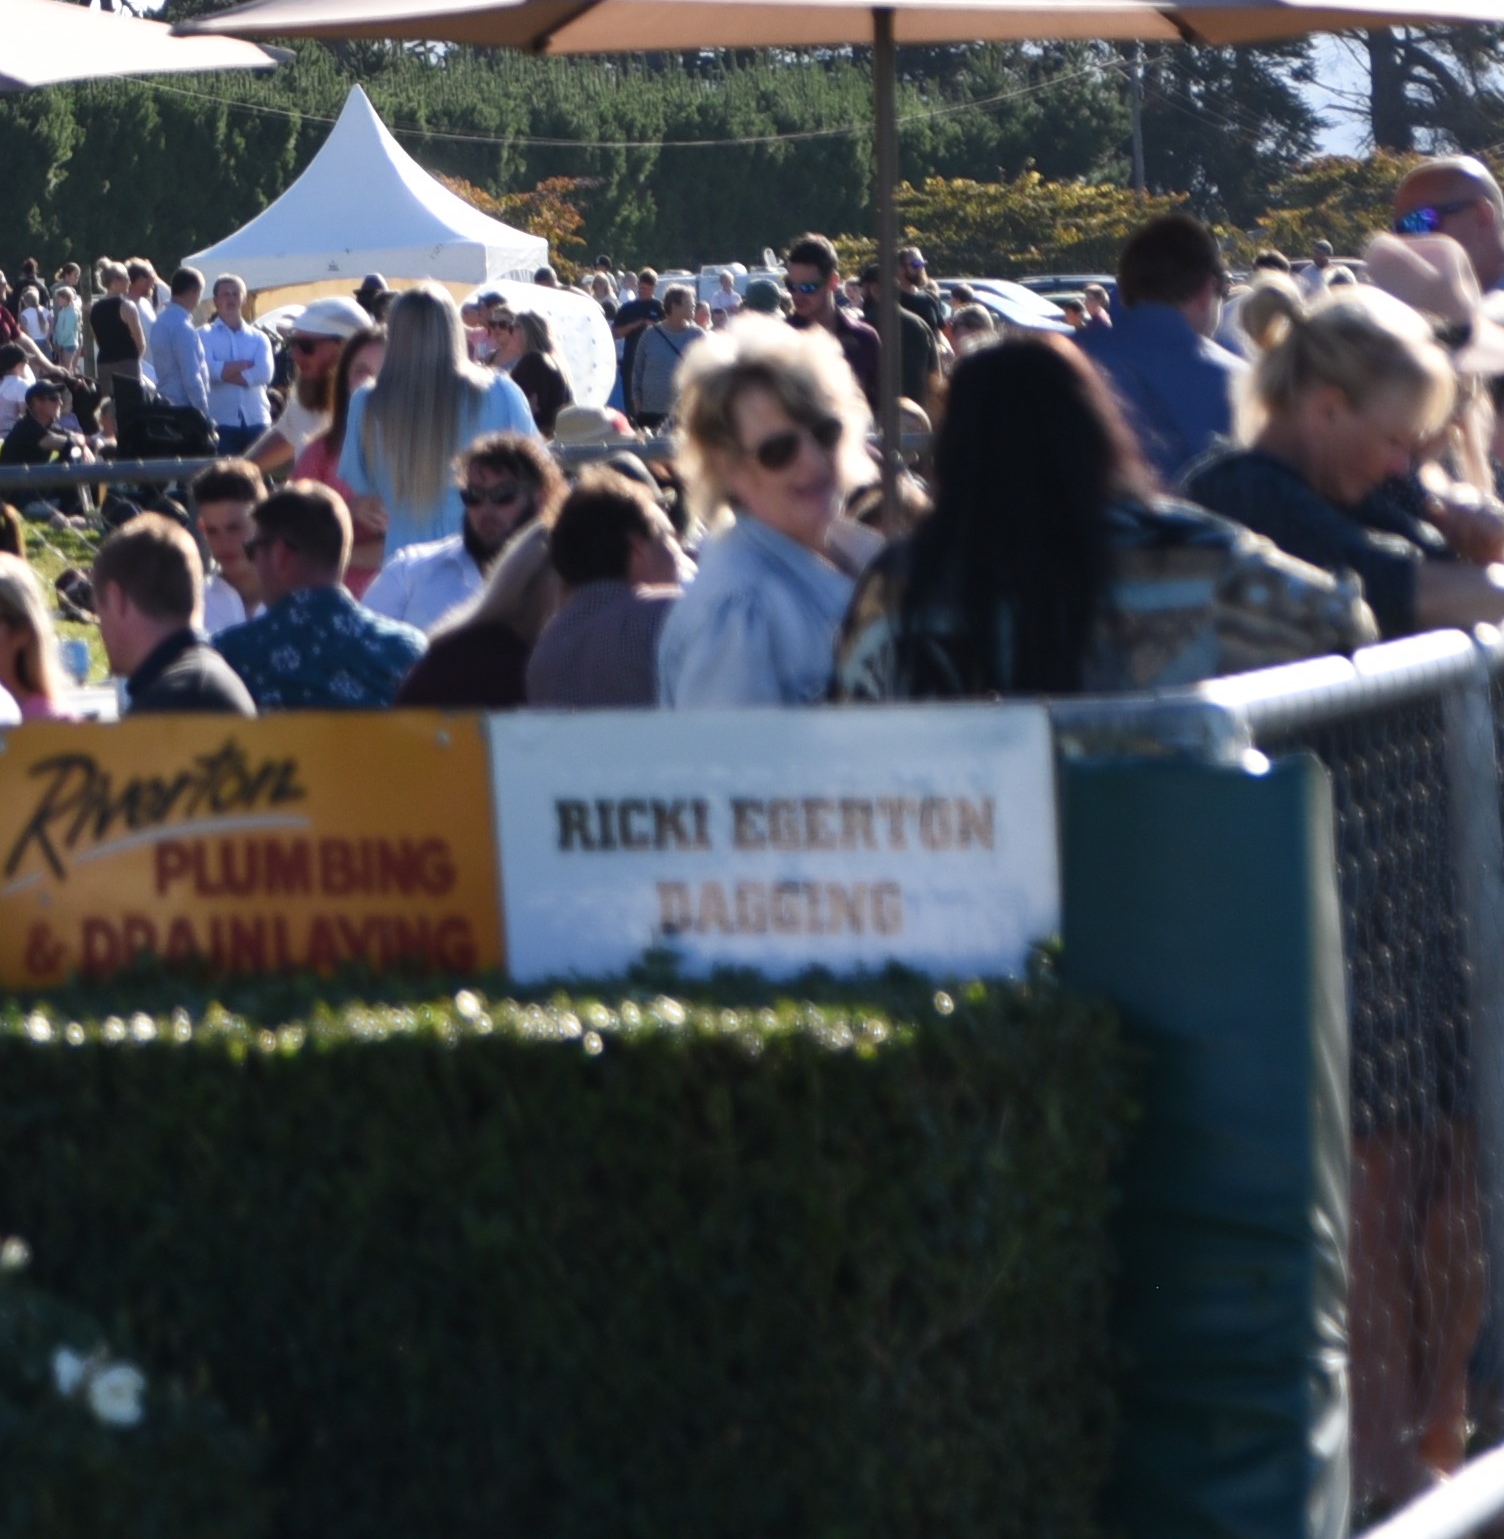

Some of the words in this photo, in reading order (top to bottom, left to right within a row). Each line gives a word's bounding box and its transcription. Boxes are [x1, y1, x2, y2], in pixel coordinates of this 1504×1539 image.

[3, 737, 306, 882] Riverton
[555, 798, 712, 853] RICKI
[730, 796, 996, 853] EGERTON
[155, 837, 455, 898] PLUMBING
[26, 921, 67, 979] &
